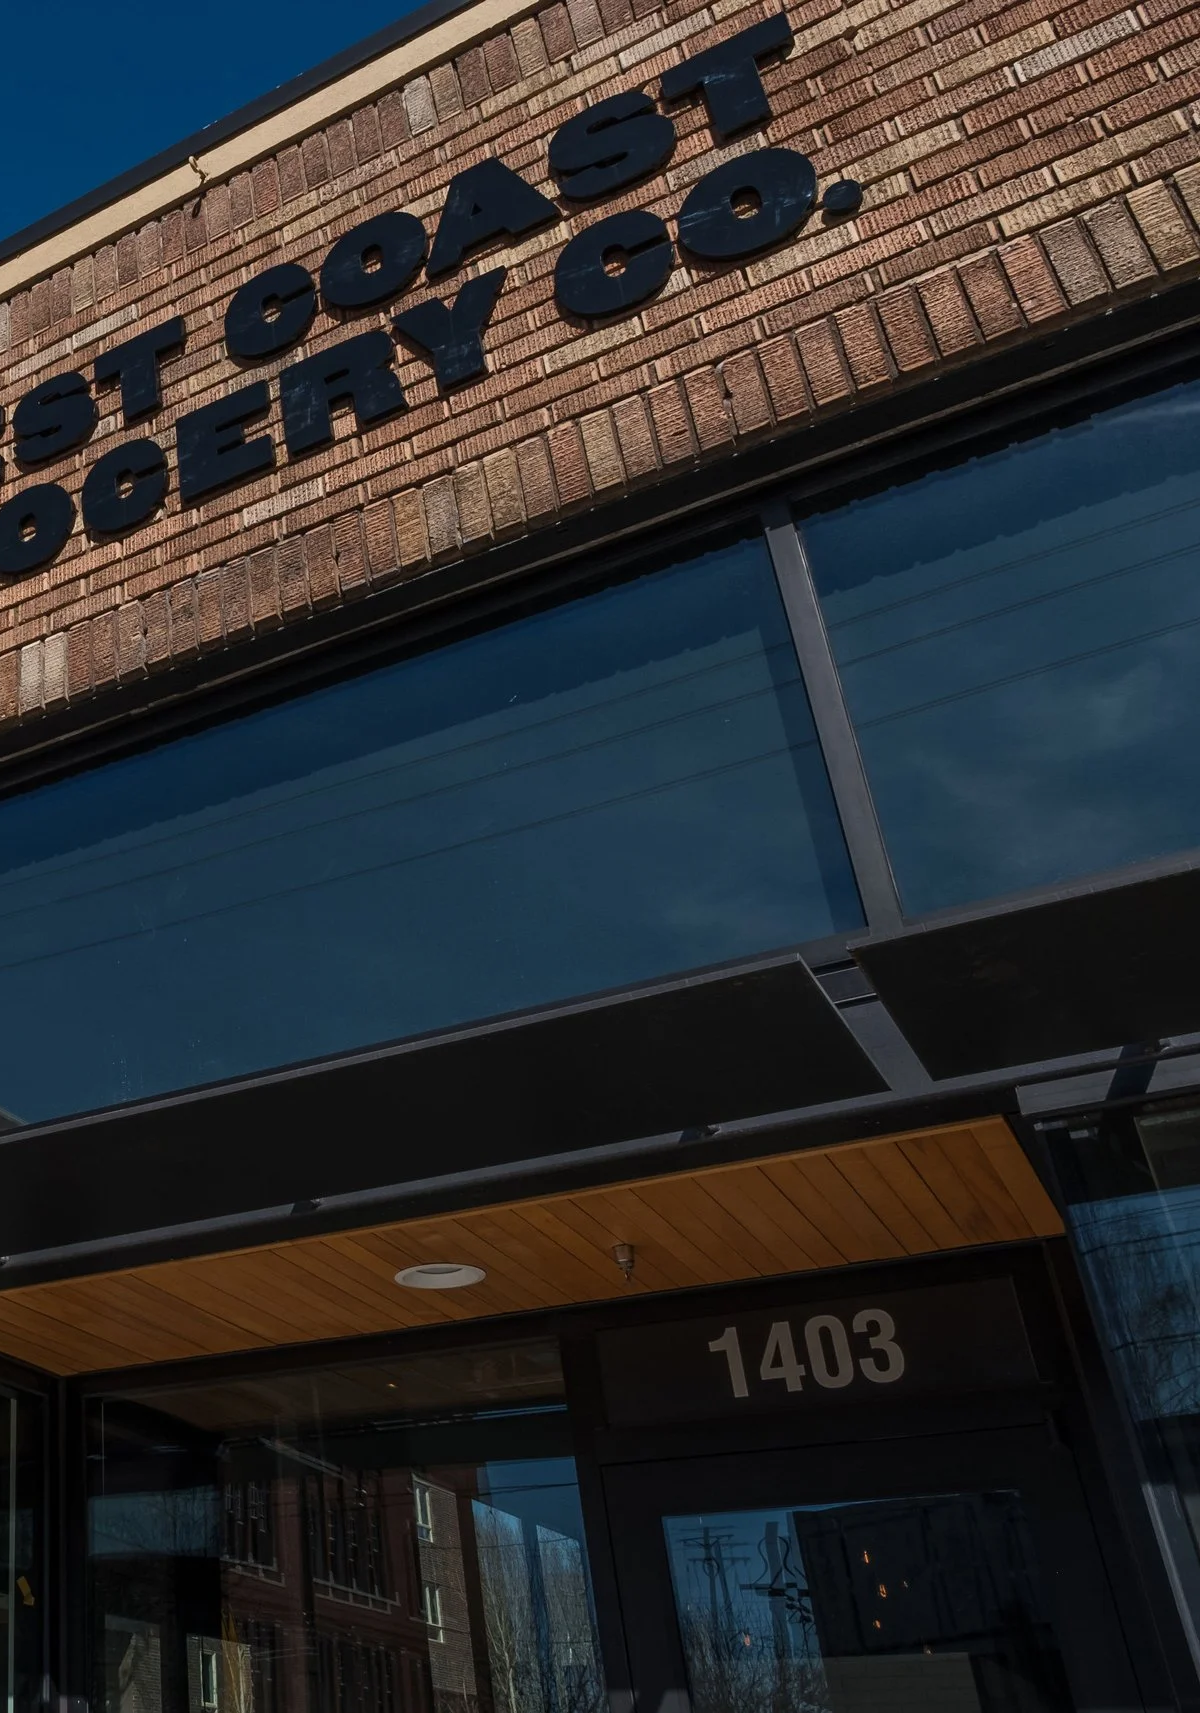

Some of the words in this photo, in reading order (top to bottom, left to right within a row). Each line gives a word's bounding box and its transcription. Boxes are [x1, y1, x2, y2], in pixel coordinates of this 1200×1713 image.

[224, 14, 794, 361] COAST
[553, 147, 863, 319] CO.
[708, 1308, 905, 1398] 1403
